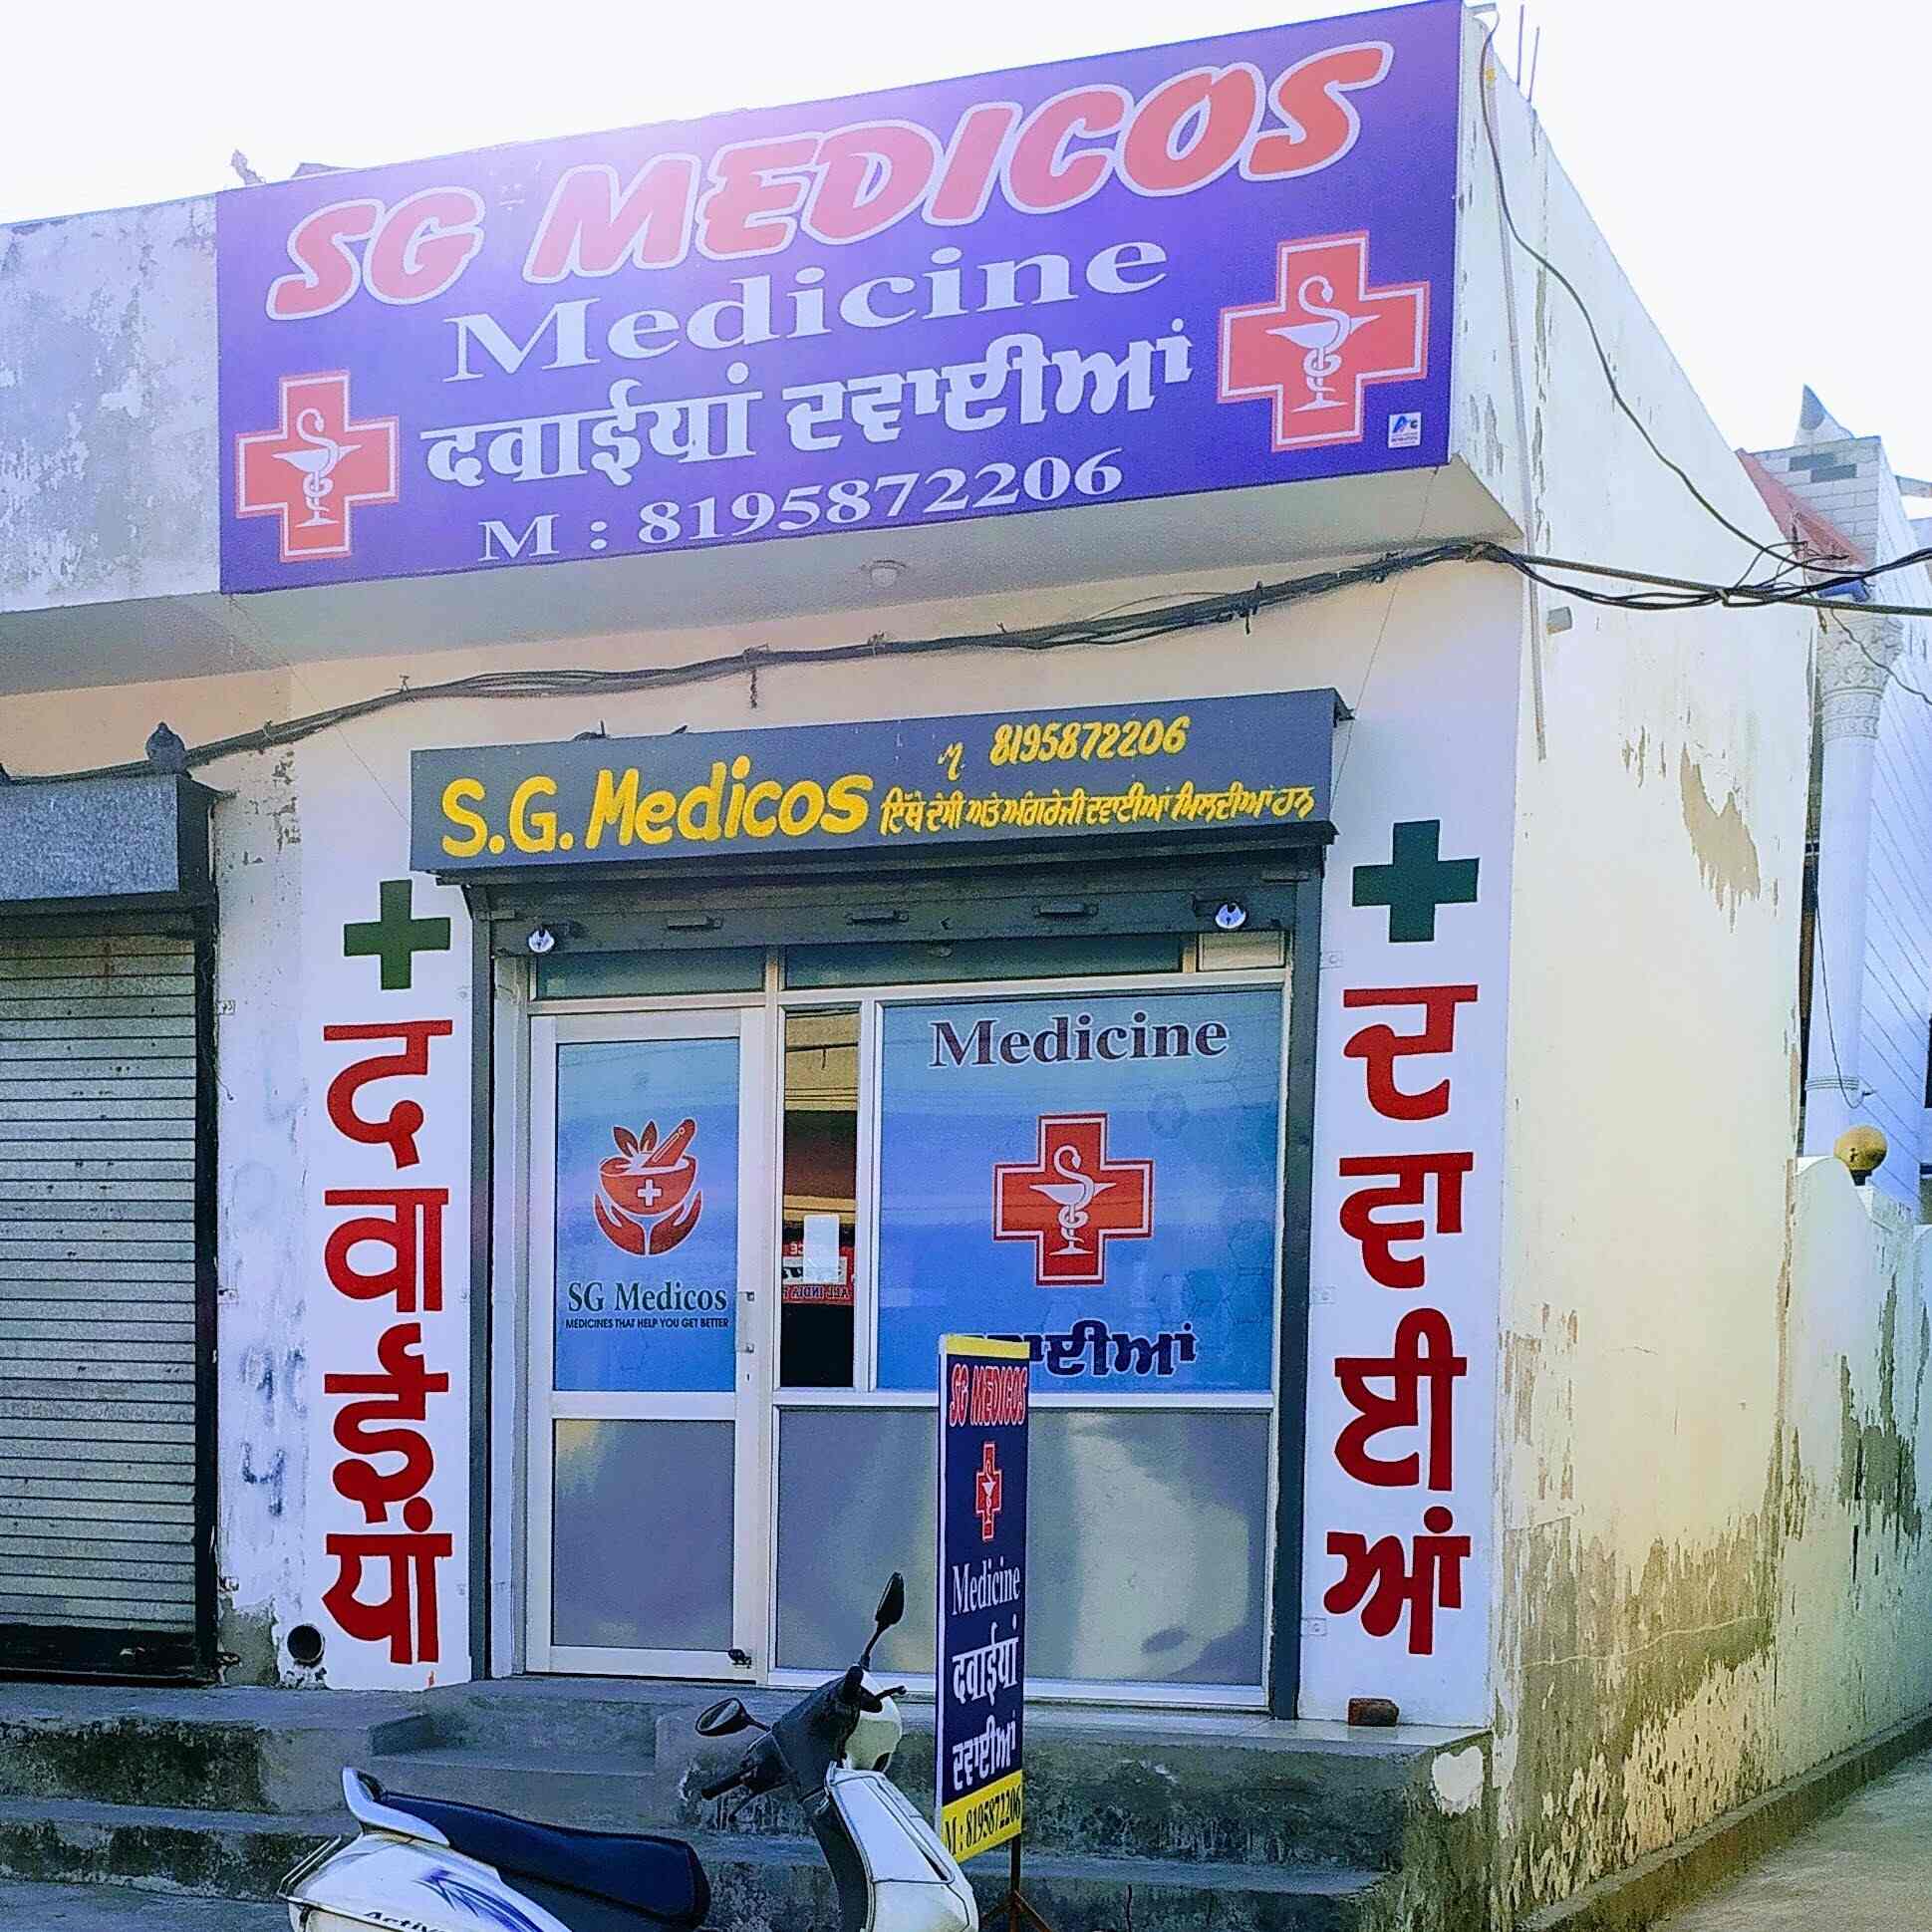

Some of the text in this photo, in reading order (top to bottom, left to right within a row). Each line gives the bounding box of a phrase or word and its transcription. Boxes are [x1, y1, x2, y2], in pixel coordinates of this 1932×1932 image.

[266, 41, 1393, 320] SG MEDICOS
[442, 242, 1168, 383] Medicine
[419, 362, 763, 485] दवाईयां
[782, 318, 1193, 451] ਦਵਾਈਆਂ
[639, 447, 1124, 545] 8195872206
[989, 715, 1192, 766] 8195872206
[441, 755, 874, 858] S.G. Medicos
[929, 1011, 1229, 1069] Medicine
[565, 1317, 729, 1328] MEDICINES THAT HELP YOU GET BETTER
[568, 1280, 727, 1311] SG Medicos
[950, 1363, 1028, 1426] SG MEDICOS
[952, 1556, 1020, 1616] Medicine
[953, 1613, 1018, 1706] दवाईयां
[953, 1710, 1016, 1791] ਦਵਾਈਆਂ
[966, 1785, 1021, 1848] 8195872206
